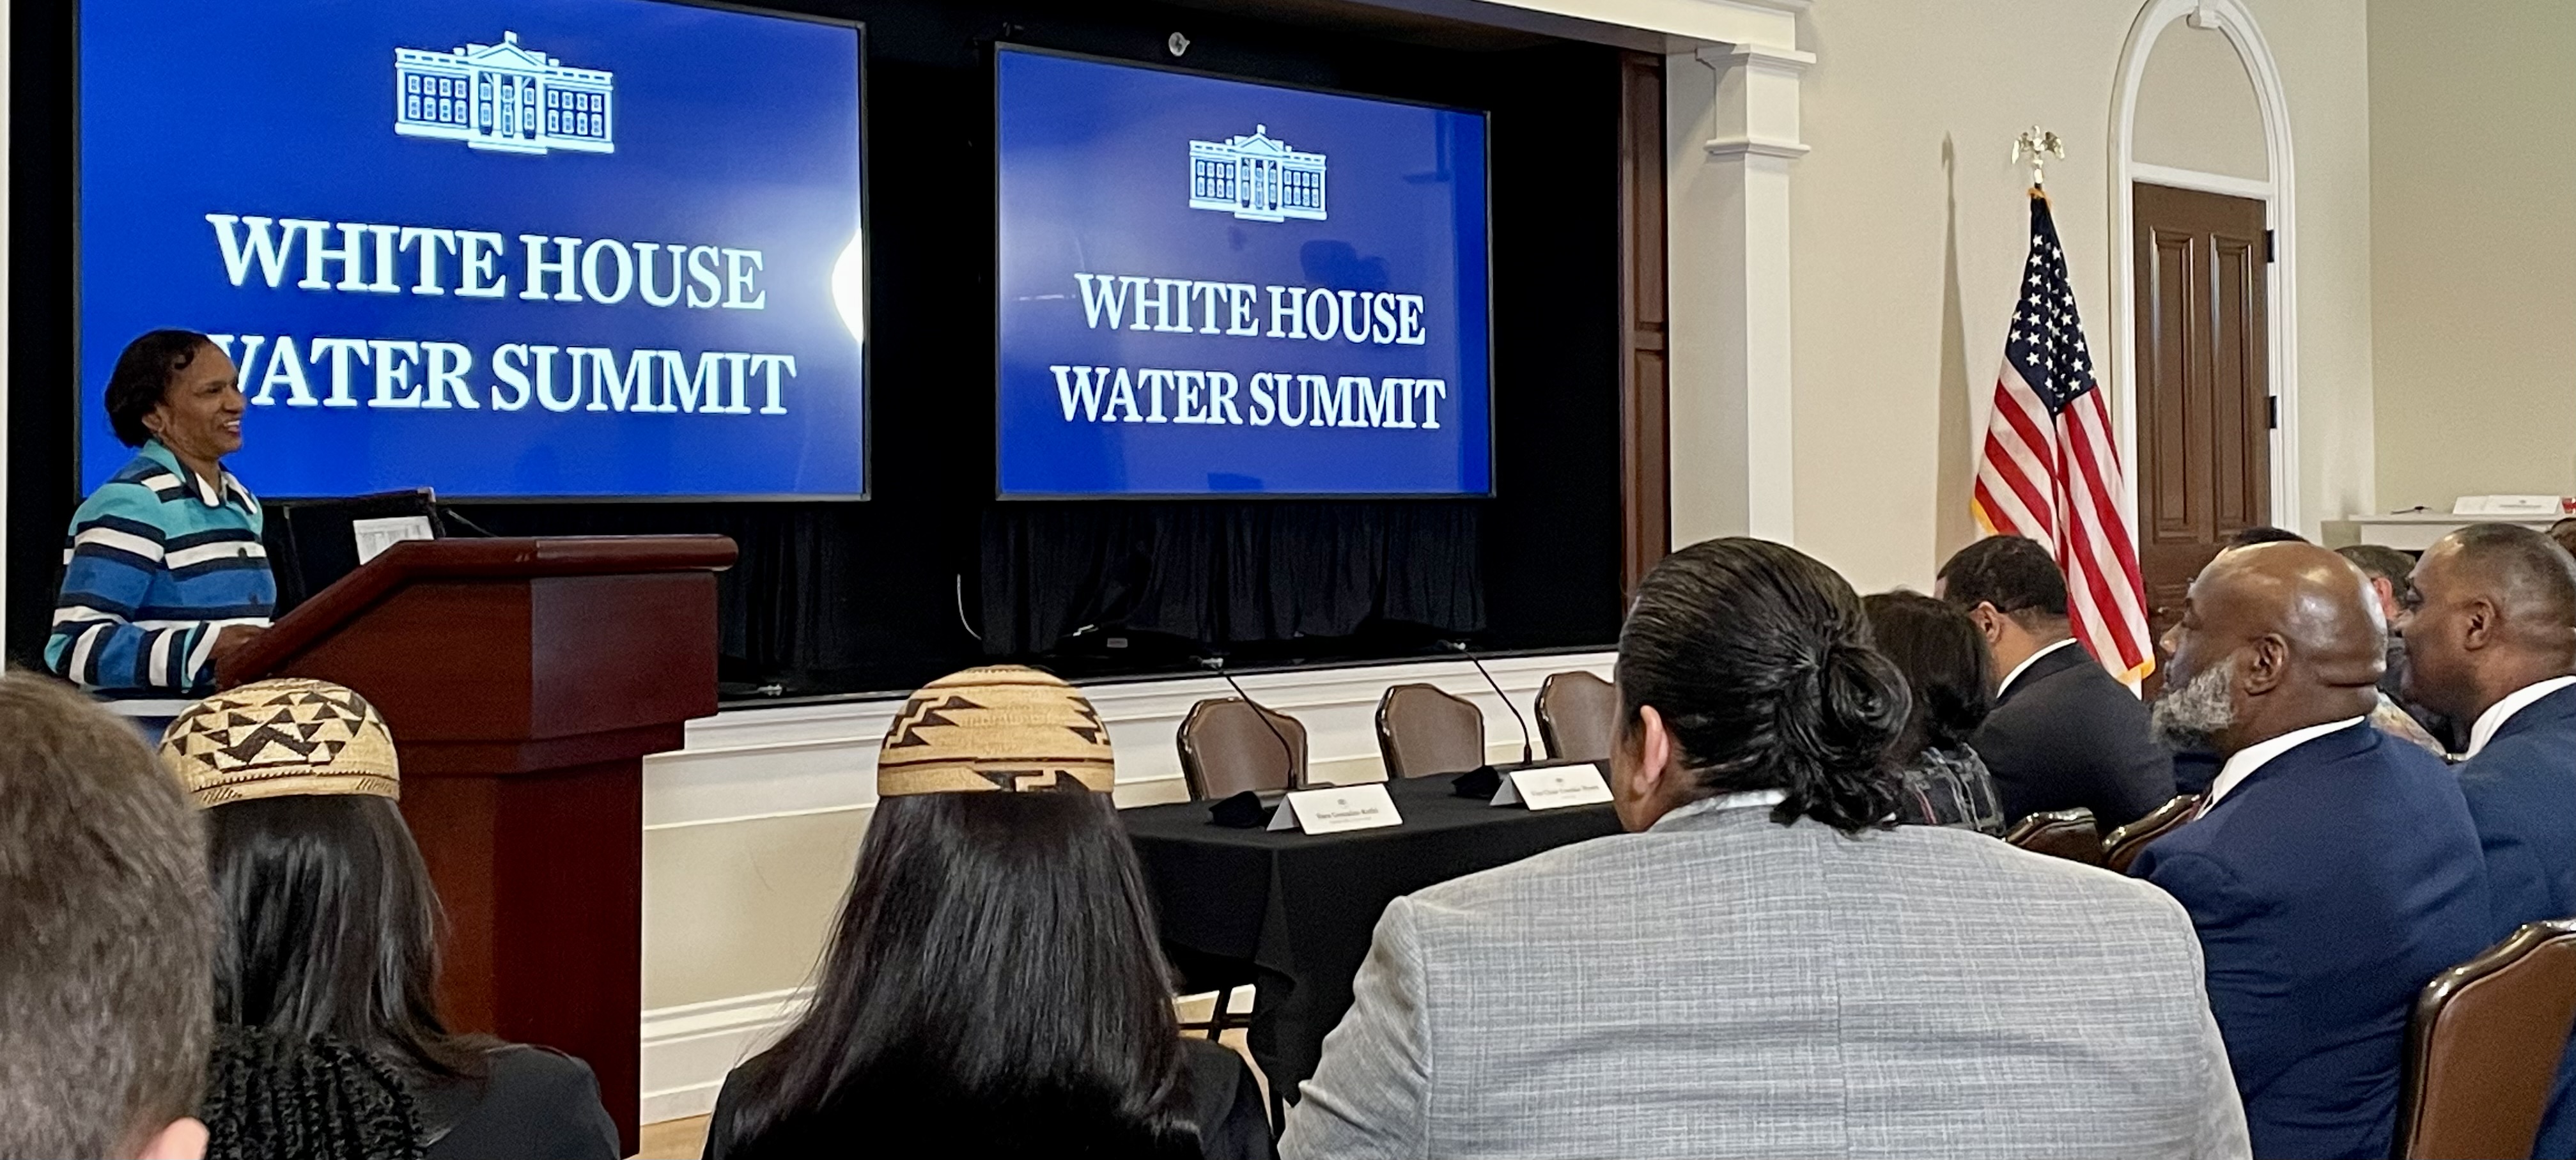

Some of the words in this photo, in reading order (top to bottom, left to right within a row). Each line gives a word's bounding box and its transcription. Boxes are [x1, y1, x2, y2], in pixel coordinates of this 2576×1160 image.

[205, 213, 507, 298] WHITE
[518, 234, 766, 310] HOUSE
[1074, 273, 1259, 337] WHITE
[1266, 285, 1426, 346] HOUSE
[491, 343, 796, 415] SUMMIT
[1050, 365, 1243, 425] WATER
[1250, 373, 1447, 429] SUMMIT
